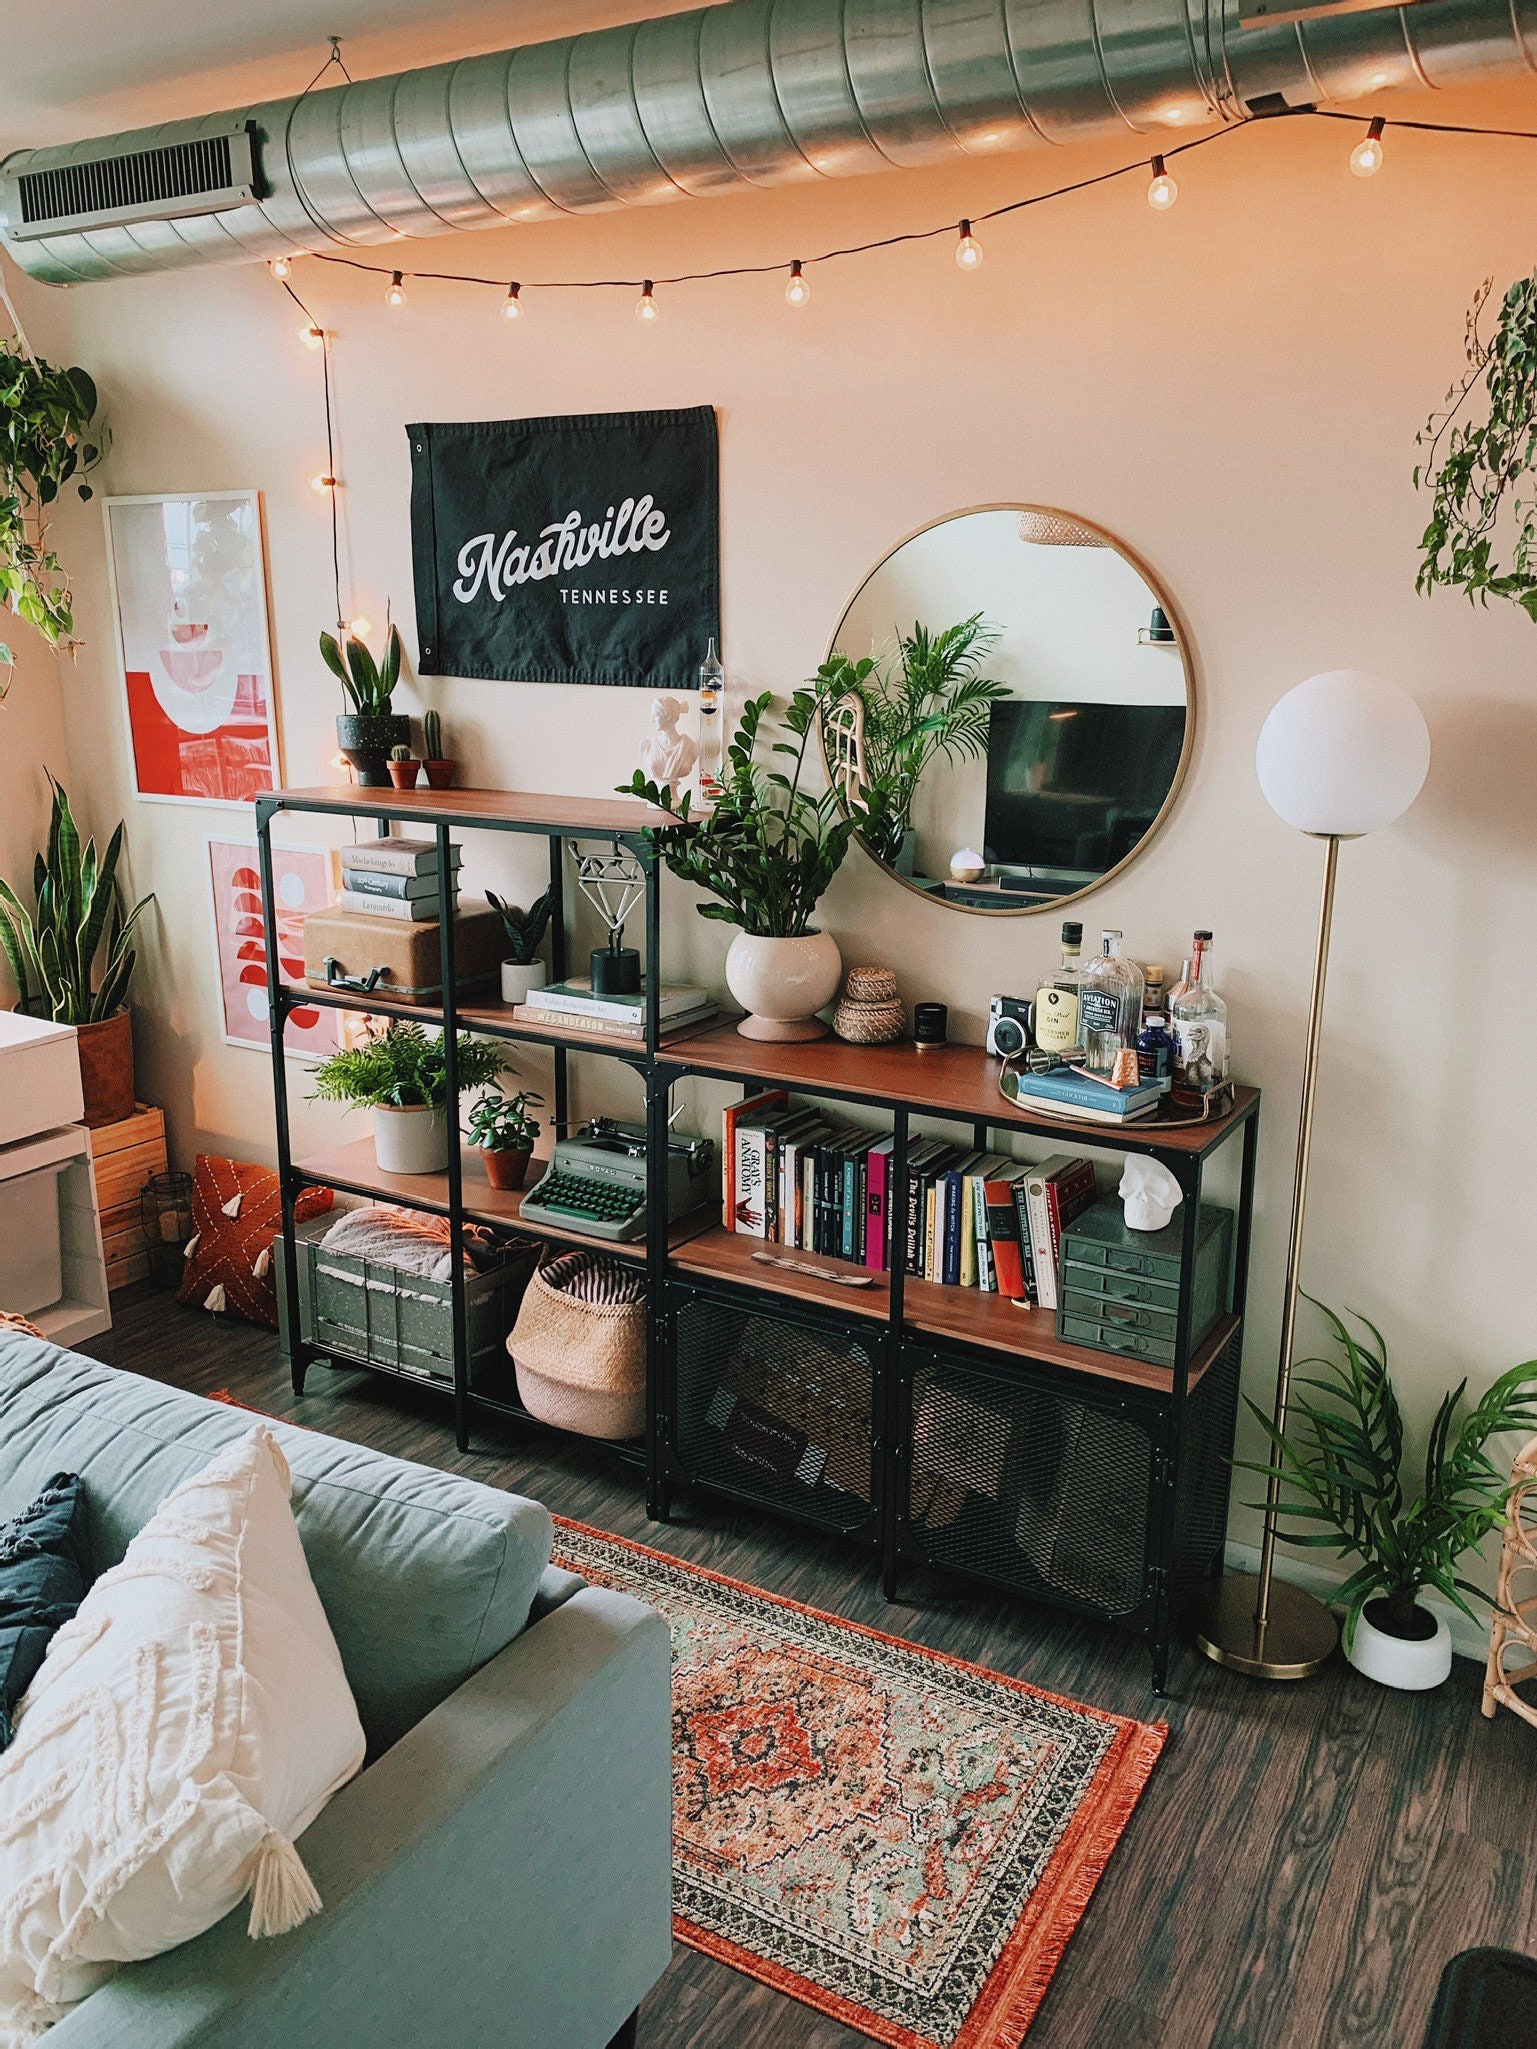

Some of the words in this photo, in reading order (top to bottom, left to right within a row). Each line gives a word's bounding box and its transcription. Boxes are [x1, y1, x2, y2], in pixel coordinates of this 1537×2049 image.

[453, 494, 671, 603] Nashville
[560, 589, 669, 604] TENNESSEE
[352, 854, 395, 868] Michelangelo
[368, 878, 389, 889] Century
[363, 900, 394, 912] Leonardo
[544, 998, 561, 1006] Italian
[562, 1000, 596, 1012] Renaissance
[1083, 994, 1117, 1008] AVIATION
[537, 1011, 557, 1024] WES
[558, 1016, 604, 1031] ANDERSON
[1046, 1016, 1059, 1024] GIN
[589, 1165, 615, 1175] ROYAL
[741, 1137, 751, 1196] ANATOMY
[751, 1149, 762, 1187] GRAY'S
[909, 1179, 919, 1194] The
[908, 1196, 918, 1226] Devil's
[1019, 1204, 1029, 1244] ILLUSTRATED
[906, 1228, 917, 1259] Delilah
